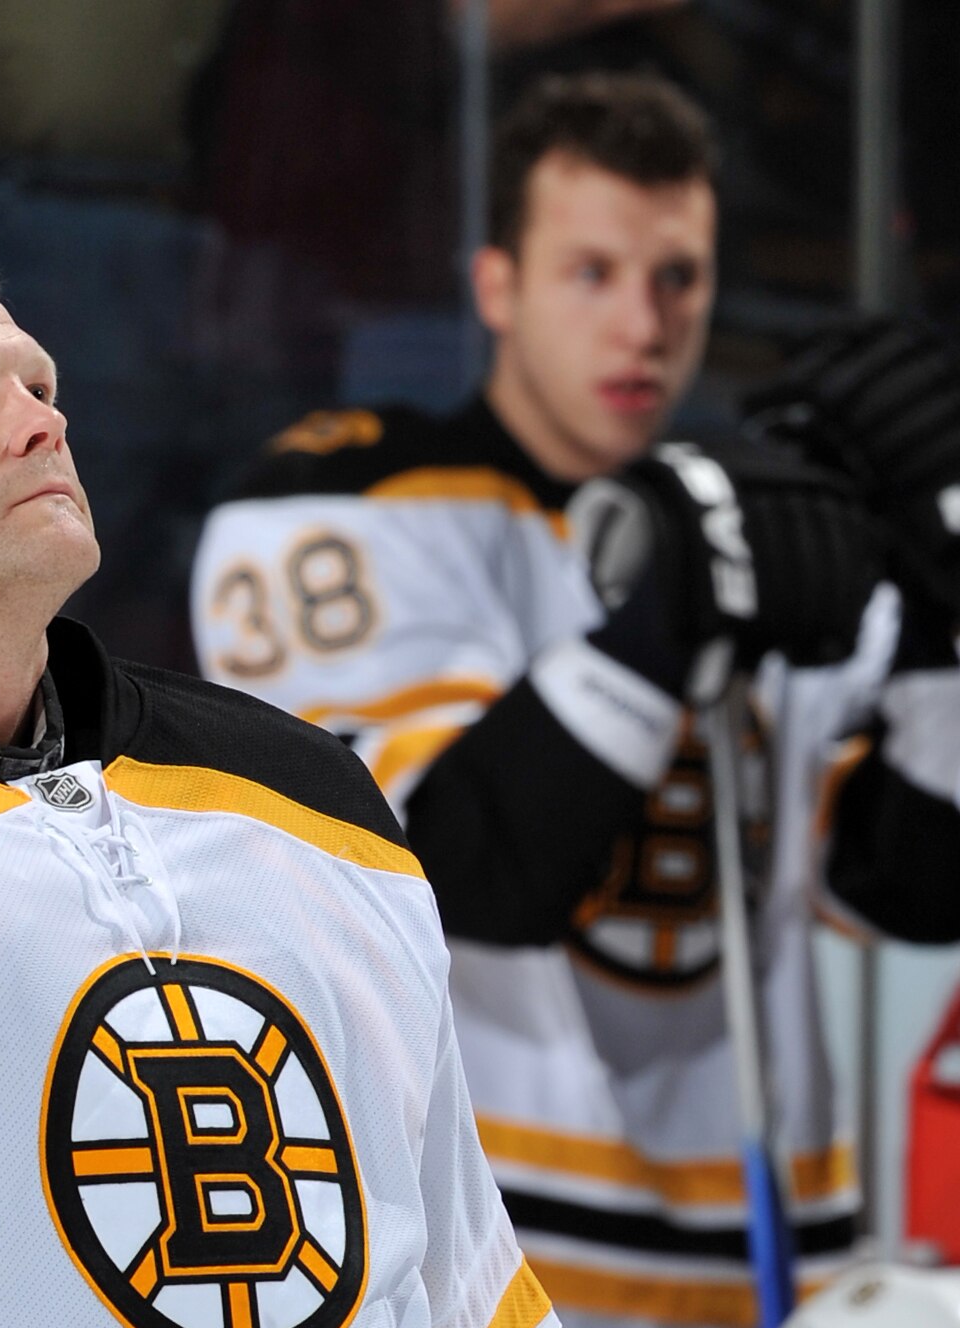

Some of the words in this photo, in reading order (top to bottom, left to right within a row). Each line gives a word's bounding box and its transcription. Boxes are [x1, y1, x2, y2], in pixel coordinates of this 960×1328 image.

[208, 528, 380, 682] 38
[53, 776, 77, 805] NHL
[126, 1047, 301, 1278] B
